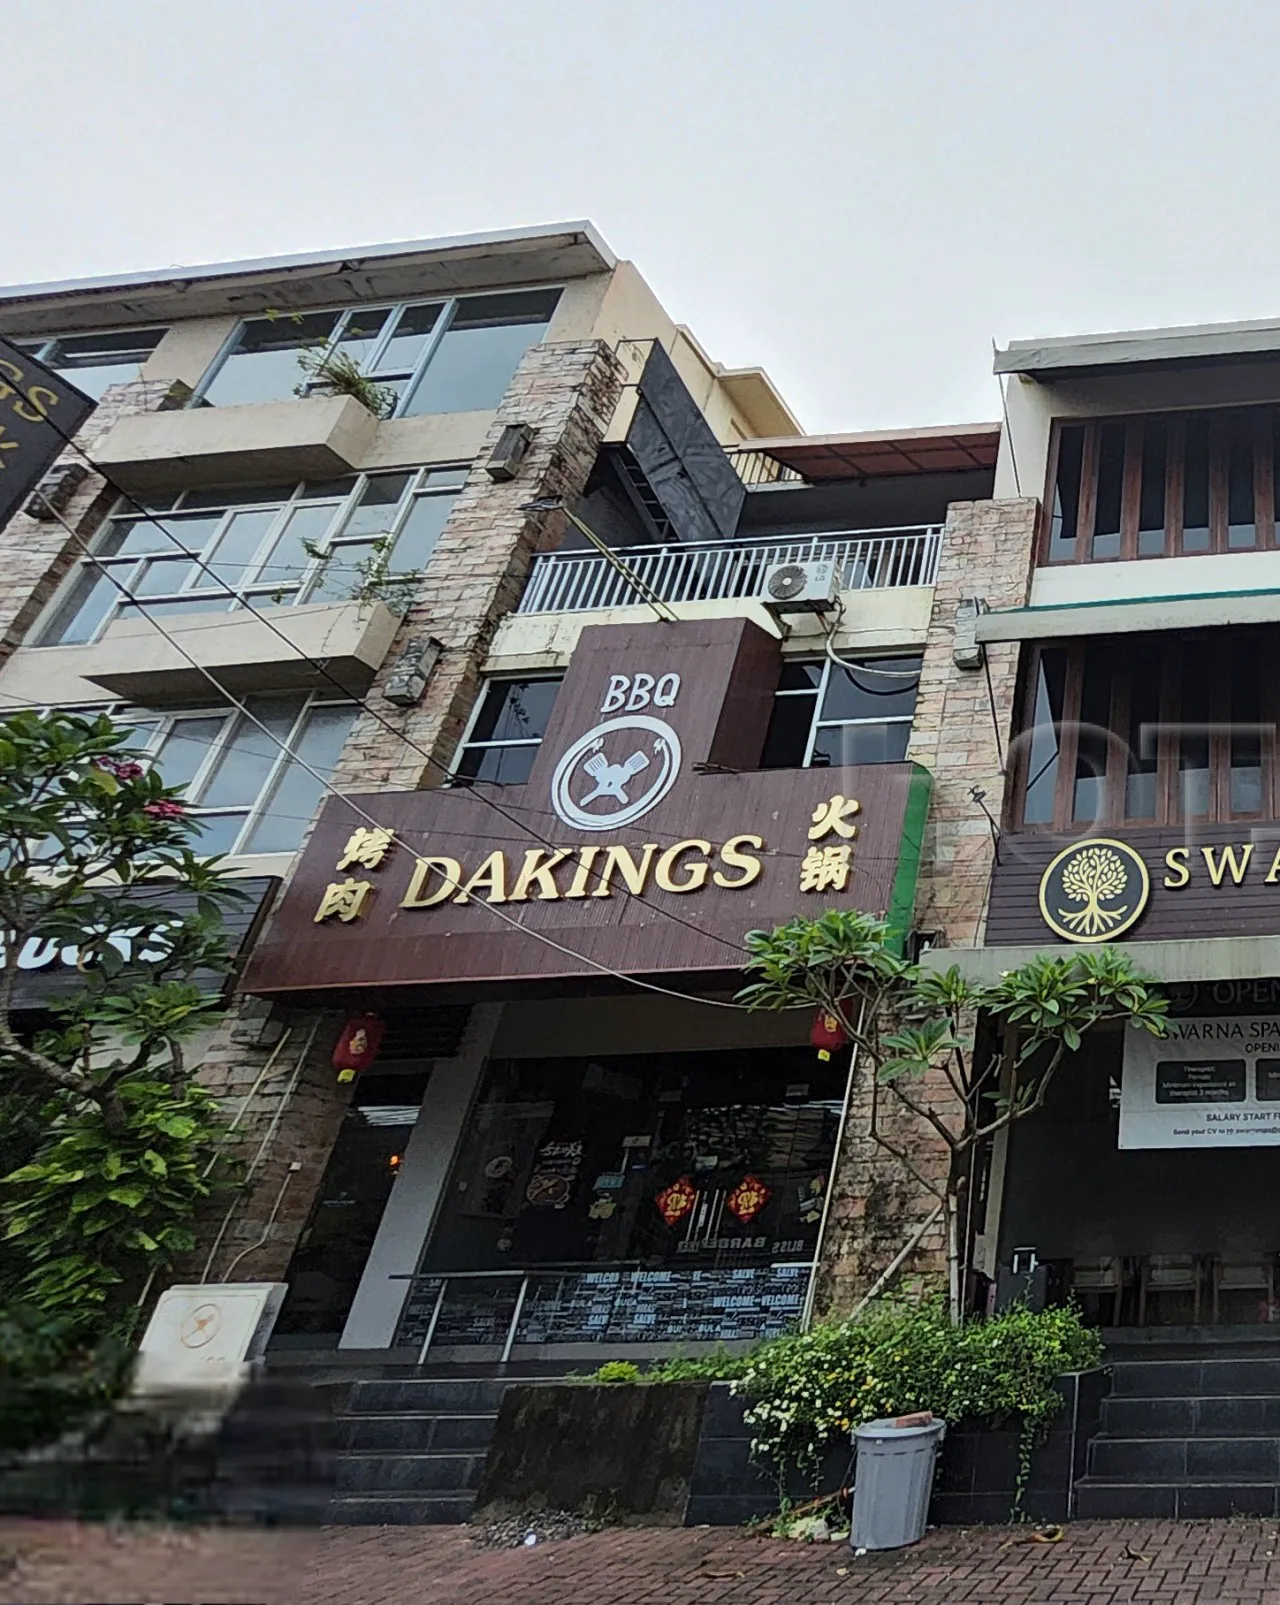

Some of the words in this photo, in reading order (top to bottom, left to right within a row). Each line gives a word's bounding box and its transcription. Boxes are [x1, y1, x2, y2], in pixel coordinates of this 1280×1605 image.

[602, 672, 682, 713] BBQ
[400, 835, 765, 910] DAKINGS
[799, 795, 862, 894] 火锅
[313, 826, 395, 924] 烤肉
[1206, 1113, 1242, 1122] SALARY
[1243, 1112, 1271, 1121] START
[713, 1294, 755, 1307] WELCOME
